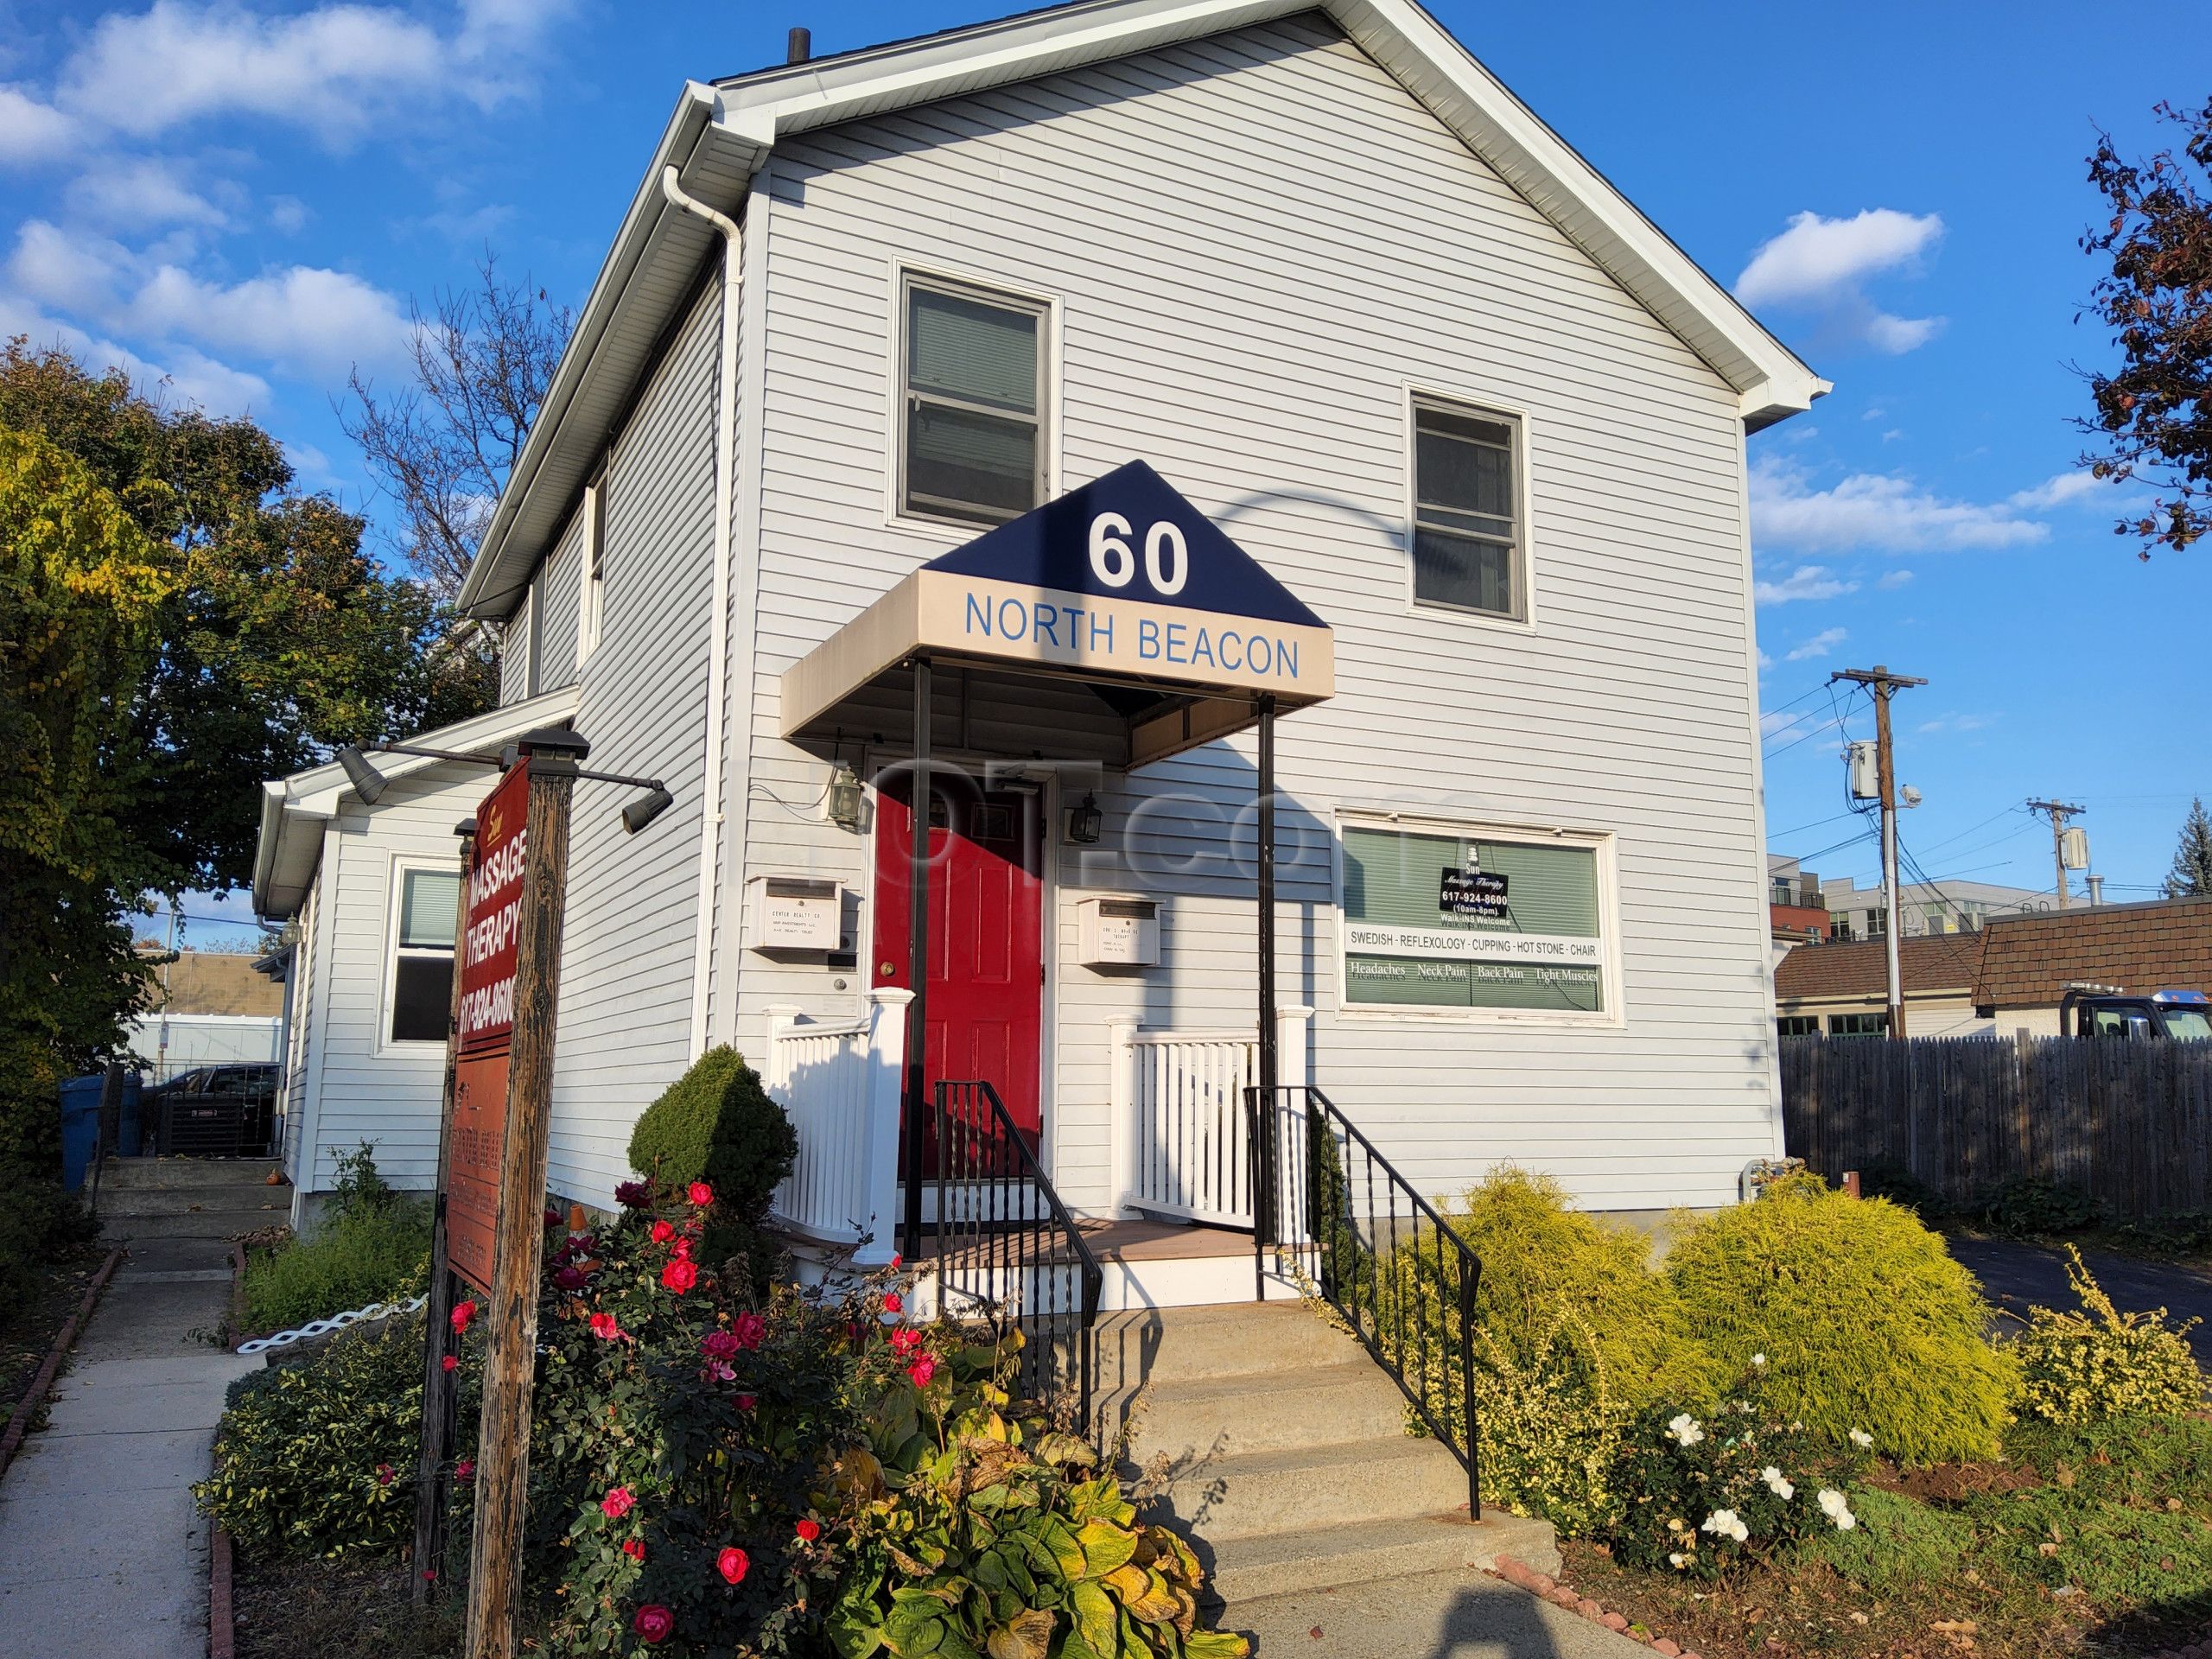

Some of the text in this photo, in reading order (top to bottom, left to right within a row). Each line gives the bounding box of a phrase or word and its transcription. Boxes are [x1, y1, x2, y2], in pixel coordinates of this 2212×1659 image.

[1088, 511, 1189, 596] 60
[965, 592, 1299, 679] NORTH BEACON
[469, 828, 527, 912] MASSAGE
[1465, 862, 1480, 875] Sun
[1445, 874, 1504, 890] Massage Therapy
[1441, 891, 1508, 906] 617-924-8600
[1476, 915, 1511, 926] Welcome
[467, 897, 523, 969] THERAPY
[1351, 931, 1393, 946] SWEDISH
[1400, 934, 1466, 950] REFLEXOLOGY
[1472, 938, 1511, 952] CUPPING
[1516, 941, 1535, 953] HOT
[1536, 942, 1565, 955] STONE
[1570, 944, 1597, 957] CHAIR
[1351, 962, 1598, 983] Headaches Neck Pain Back Pain Tight Muscles
